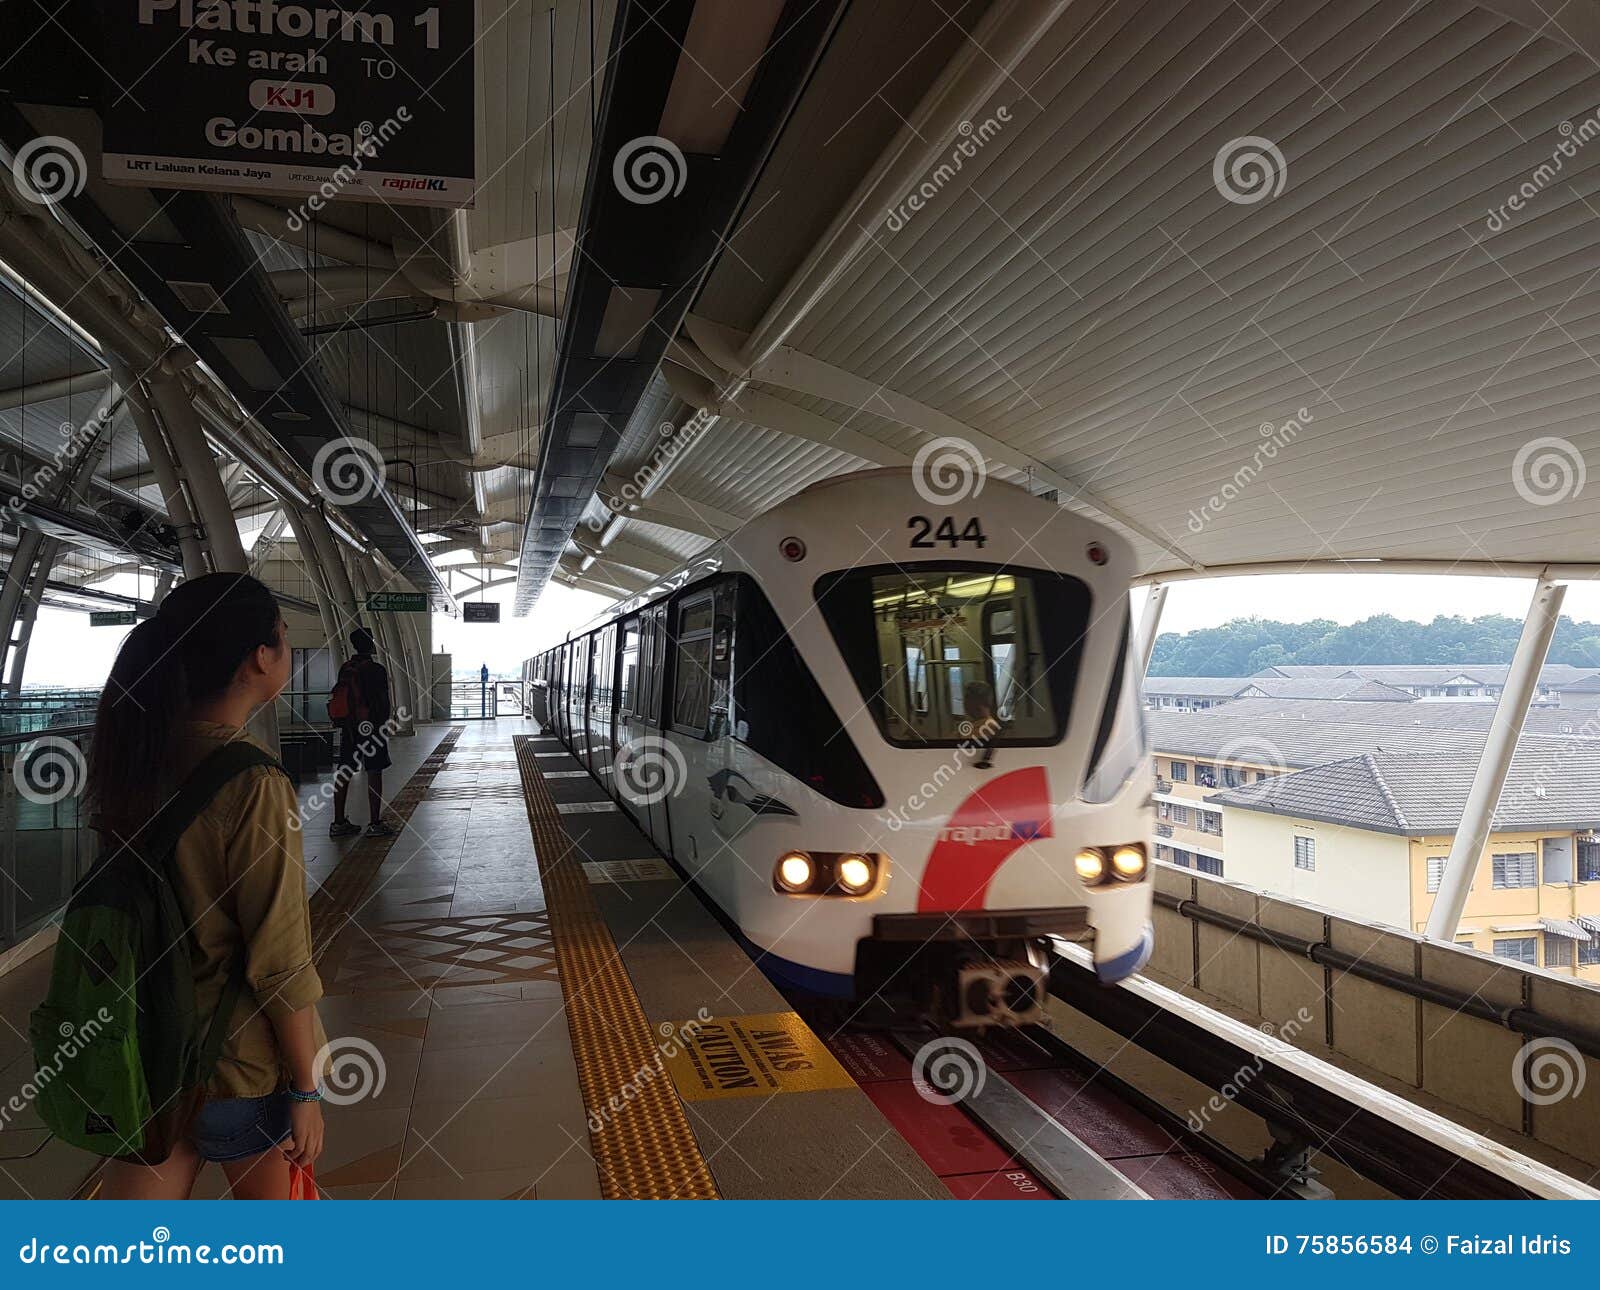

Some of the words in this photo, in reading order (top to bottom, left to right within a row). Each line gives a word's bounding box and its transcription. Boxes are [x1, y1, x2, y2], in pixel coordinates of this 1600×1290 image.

[138, 0, 394, 45] Platform
[414, 7, 440, 49] 1
[188, 38, 237, 67] Ke
[247, 48, 328, 74] arah
[360, 57, 396, 80] TO
[266, 85, 316, 109] KJ1
[204, 117, 379, 158] Gombak
[126, 159, 152, 171] LRT
[155, 161, 196, 174] Laluan
[198, 164, 241, 177] Kelana
[243, 167, 272, 180] Jaya
[382, 177, 448, 192] rapidKL
[907, 515, 988, 549] 244
[692, 1024, 759, 1090] CAUTION
[749, 1029, 814, 1072] AWAS
[1005, 1171, 1039, 1194] B30
